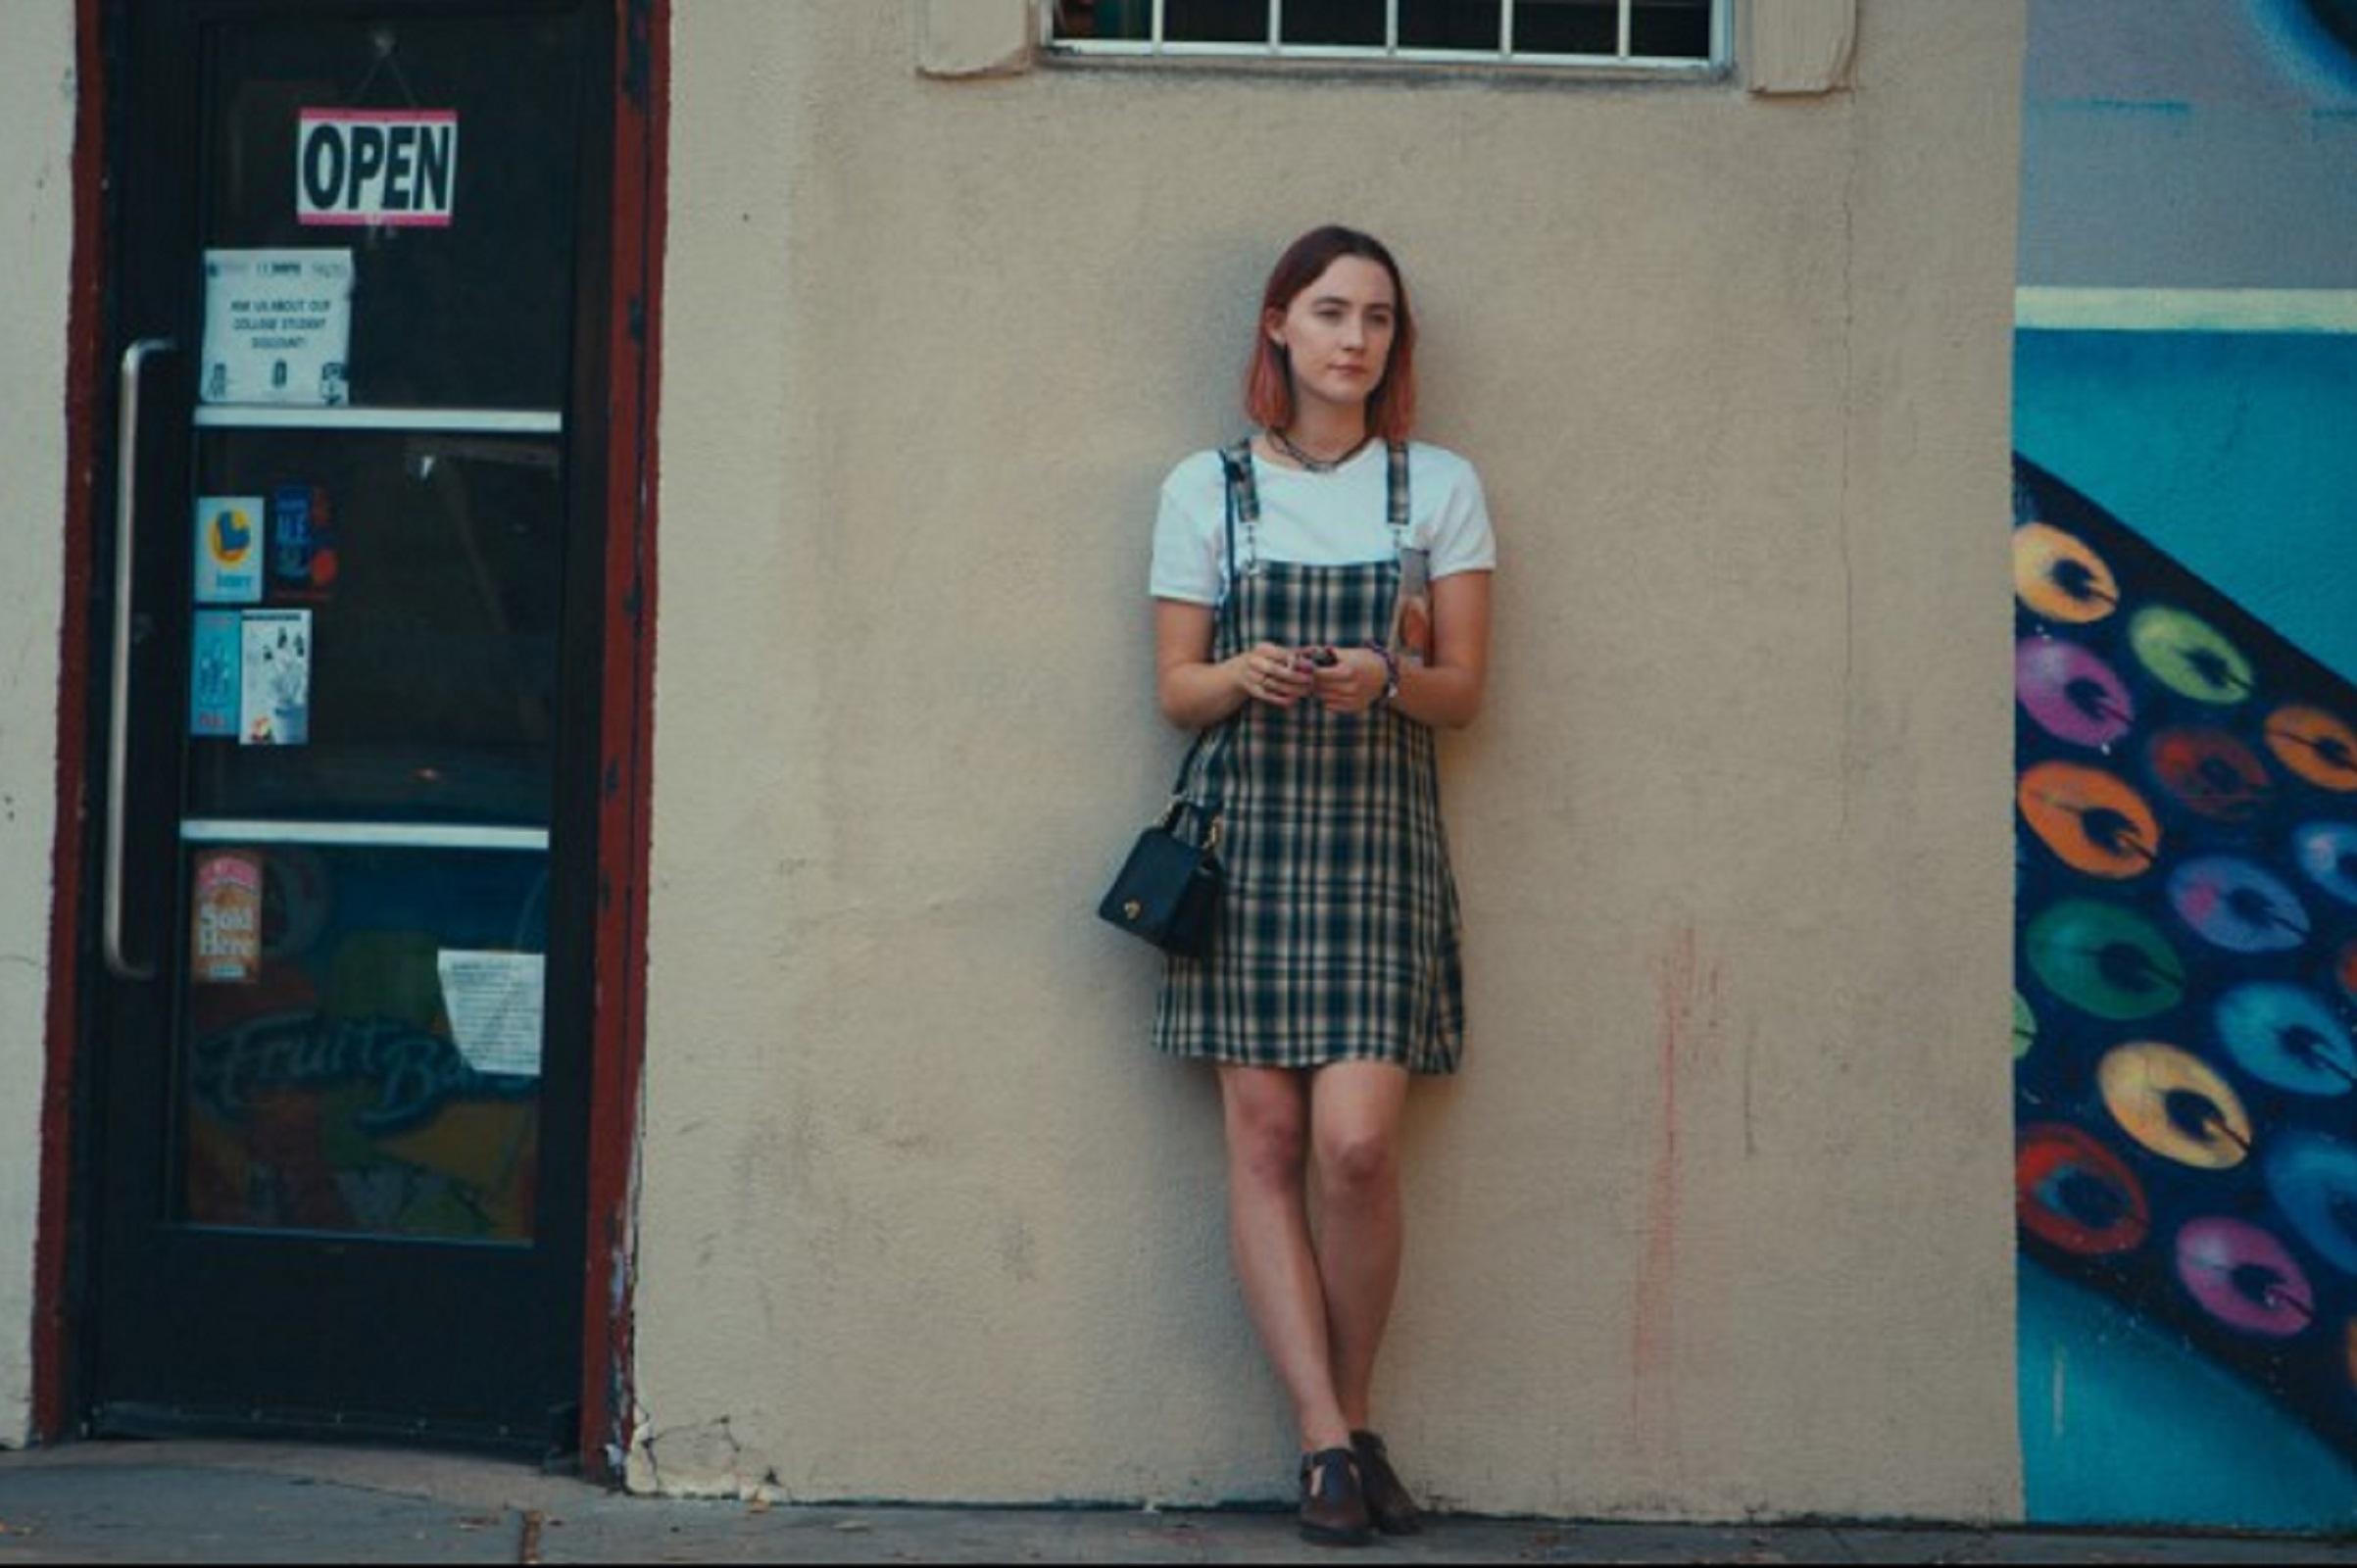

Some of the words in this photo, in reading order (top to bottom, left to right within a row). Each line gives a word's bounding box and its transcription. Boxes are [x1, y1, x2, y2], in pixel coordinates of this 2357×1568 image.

[303, 123, 450, 211] OPEN
[271, 300, 304, 312] ABOUT
[234, 318, 276, 329] COLLEGE
[282, 318, 325, 329] STUDENT
